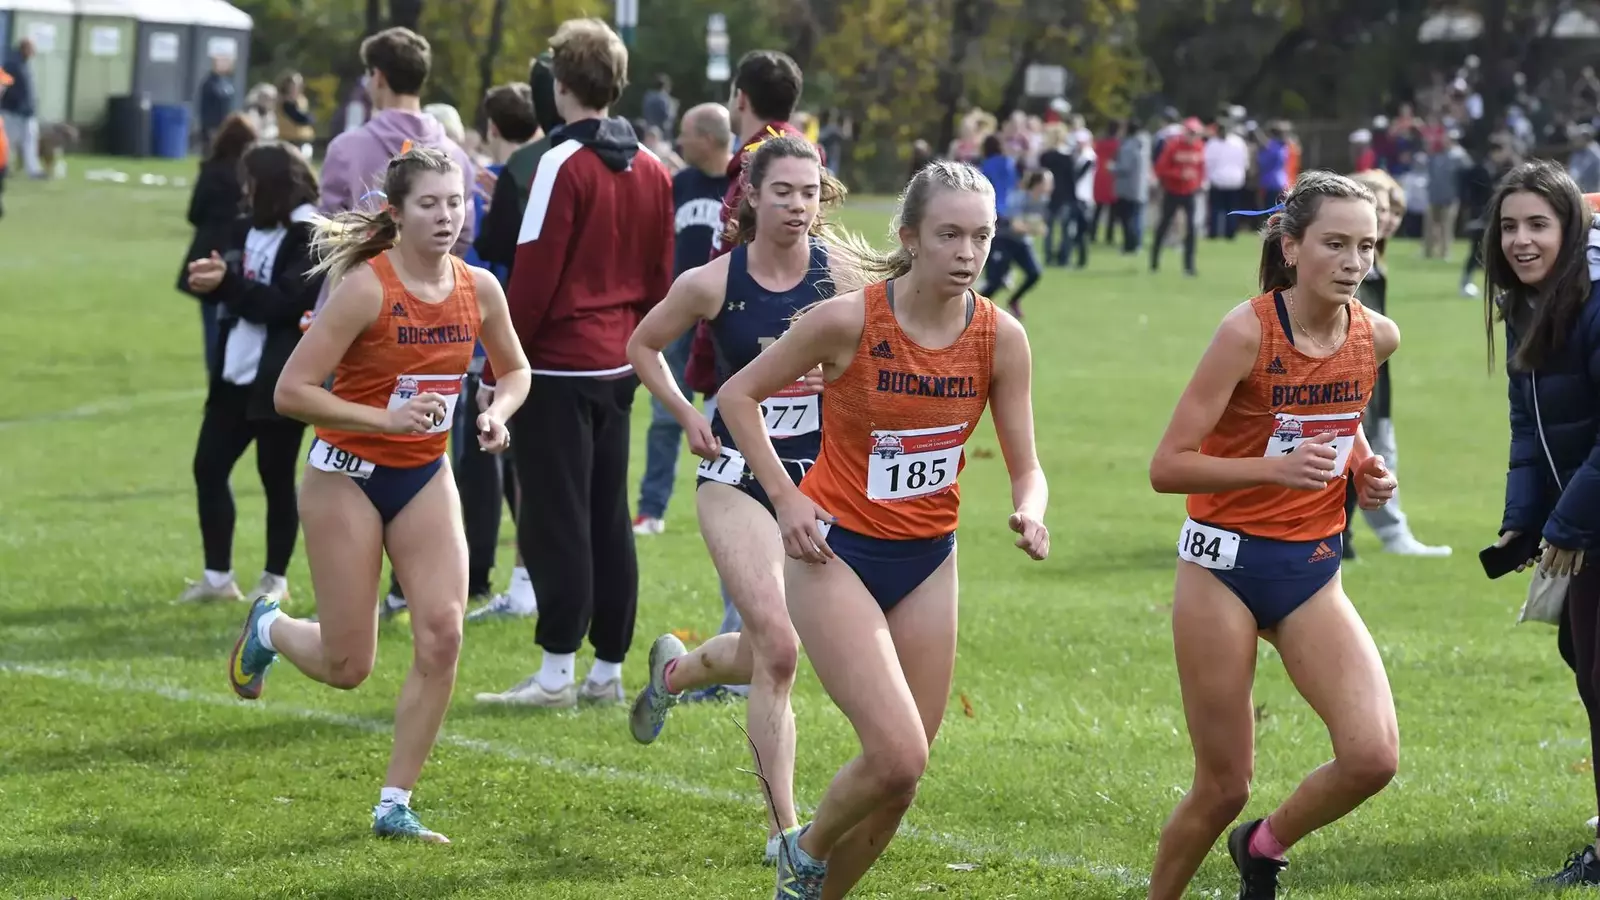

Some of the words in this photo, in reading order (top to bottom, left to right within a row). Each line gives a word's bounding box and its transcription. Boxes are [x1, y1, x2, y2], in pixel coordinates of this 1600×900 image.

[397, 324, 472, 345] BUCKNELL
[876, 369, 978, 398] BUCKNELL
[1271, 379, 1363, 407] BUCKNELL
[760, 404, 808, 429] 77
[323, 446, 362, 472] 190
[885, 457, 946, 492] 185
[1184, 527, 1221, 562] 184
[1307, 551, 1336, 564] adidas
